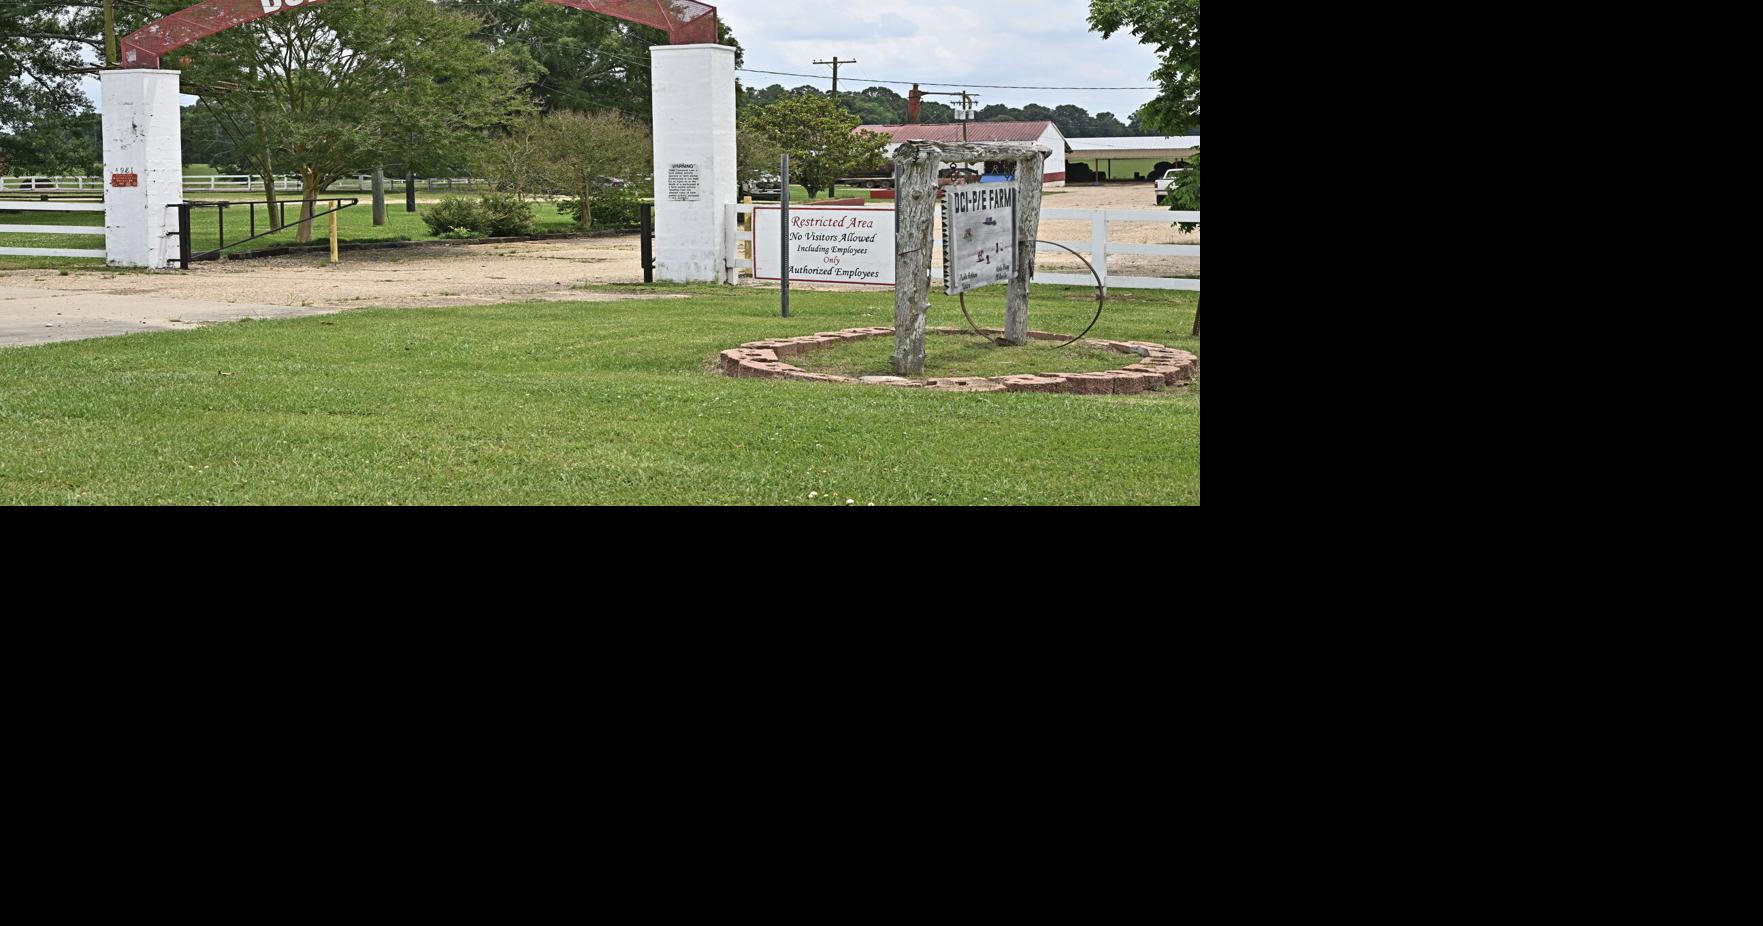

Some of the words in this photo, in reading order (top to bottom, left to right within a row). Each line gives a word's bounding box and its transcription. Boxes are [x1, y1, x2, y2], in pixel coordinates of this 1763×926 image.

[954, 190, 987, 214] DCI-P/E
[989, 187, 1012, 210] FARM
[791, 215, 847, 228] Restricted
[846, 216, 874, 229] Area
[789, 232, 803, 241] No
[804, 232, 838, 242] Visitors
[838, 232, 878, 243] Allowed
[796, 244, 830, 254] Including
[830, 245, 868, 256] Employees
[823, 256, 841, 265] Only
[788, 265, 835, 276] Authorized
[834, 267, 879, 279] Employees
